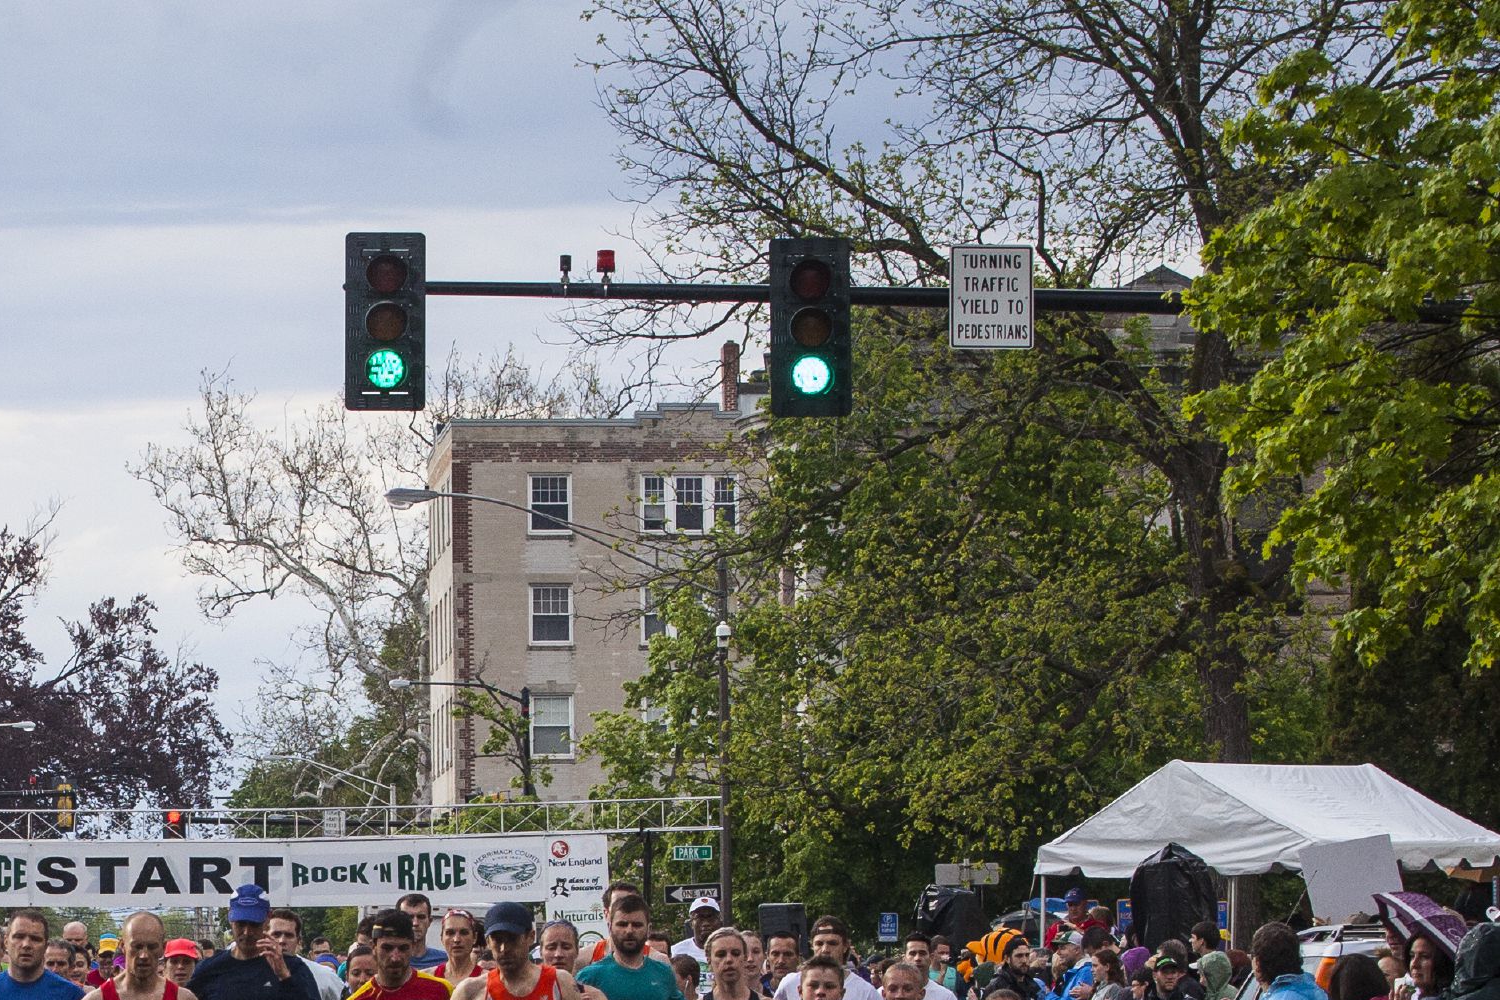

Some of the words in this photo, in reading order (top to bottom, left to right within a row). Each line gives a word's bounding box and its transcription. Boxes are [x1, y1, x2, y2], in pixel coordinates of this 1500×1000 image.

[962, 254, 1022, 269] TURNING
[964, 277, 1019, 292] TRAFFIC
[960, 299, 999, 315] YIELD
[1008, 299, 1024, 315] TO
[957, 323, 1028, 340] PEDESTRIANS
[473, 849, 512, 865] MERRIMACK
[515, 849, 541, 864] COUNTY
[678, 847, 699, 859] PARK
[548, 858, 567, 867] New
[568, 857, 602, 868] England
[35, 856, 284, 895] START
[291, 862, 370, 888] ROCK
[373, 862, 392, 883] 'N
[397, 852, 467, 891] RACE
[480, 880, 512, 892] SAVINGS
[515, 879, 534, 890] BANK
[682, 890, 697, 898] ONE
[700, 889, 716, 897] WAY
[554, 910, 604, 921] Naturals
